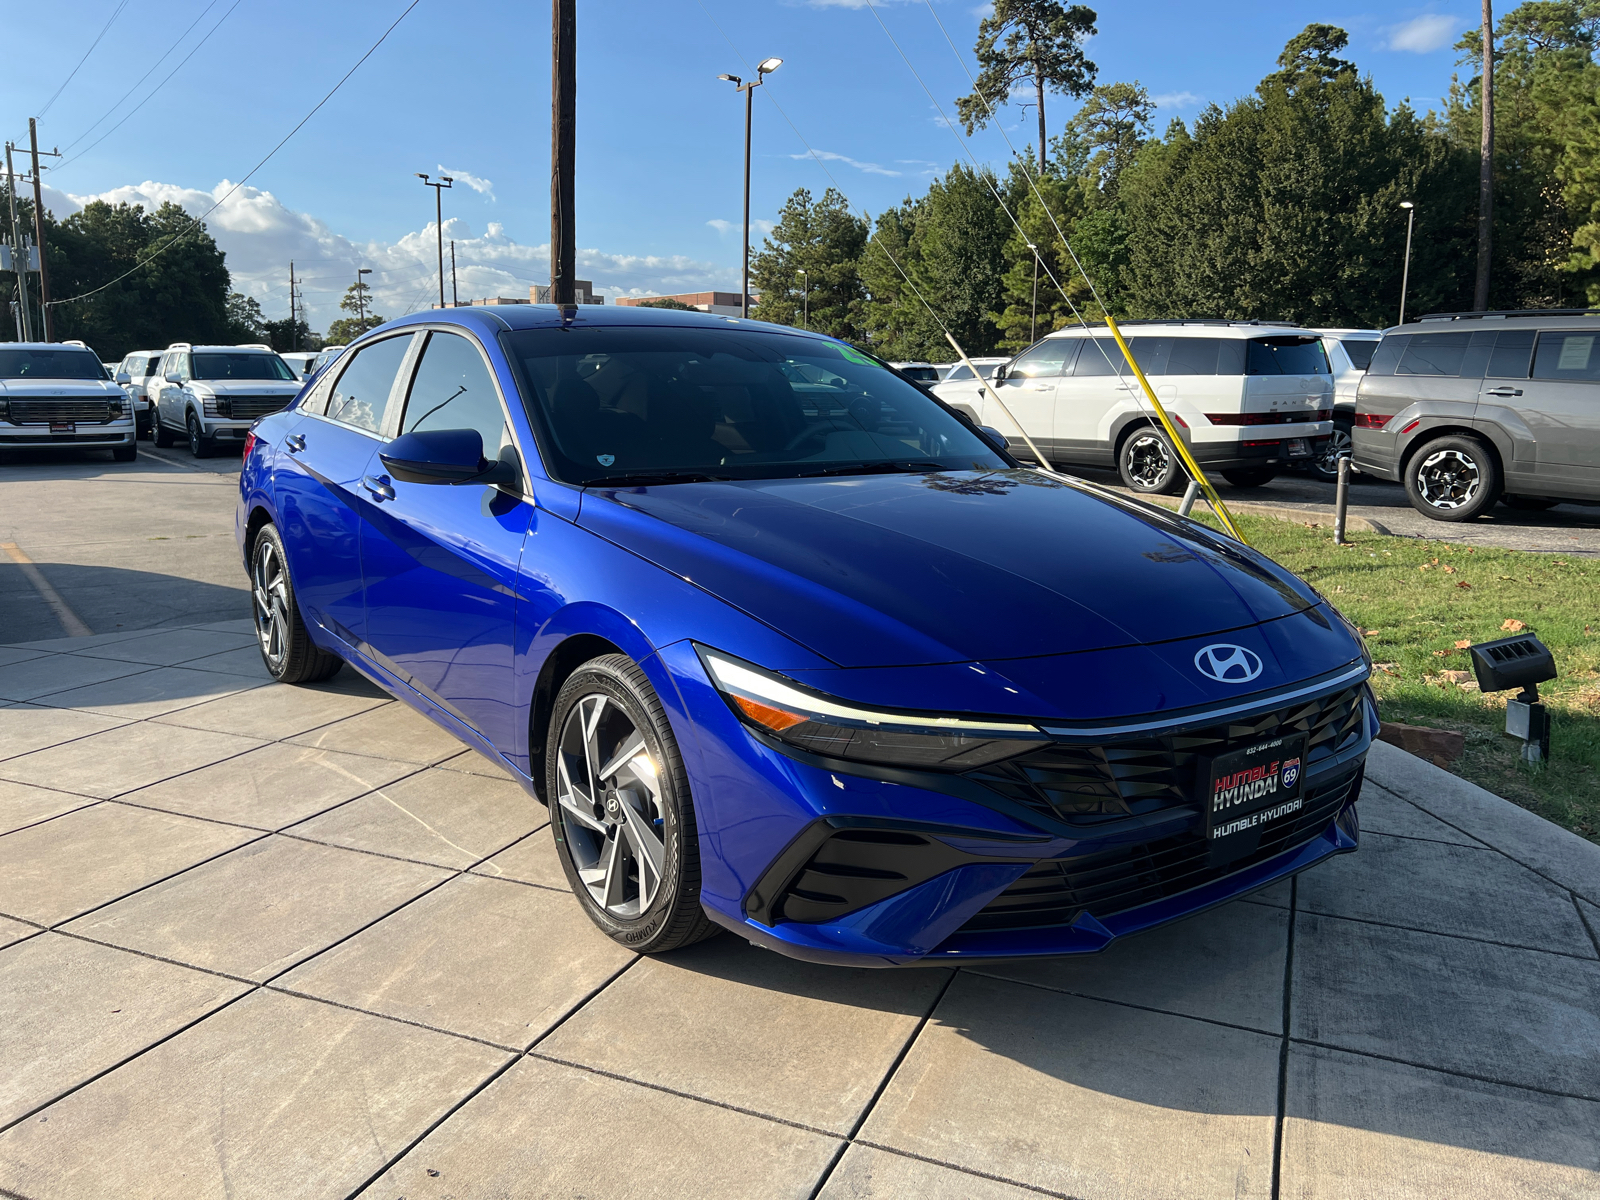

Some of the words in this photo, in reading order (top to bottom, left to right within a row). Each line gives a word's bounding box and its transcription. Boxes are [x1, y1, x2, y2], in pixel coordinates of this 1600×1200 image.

[1246, 739, 1282, 755] 832-644-4000
[1214, 761, 1279, 793] HUMBLE
[1283, 768, 1296, 784] 69
[1213, 775, 1278, 812] HYUNDAI
[1213, 815, 1258, 839] HUMBLE
[1260, 799, 1303, 823] HYUNDAI
[625, 920, 658, 943] KUMHO
